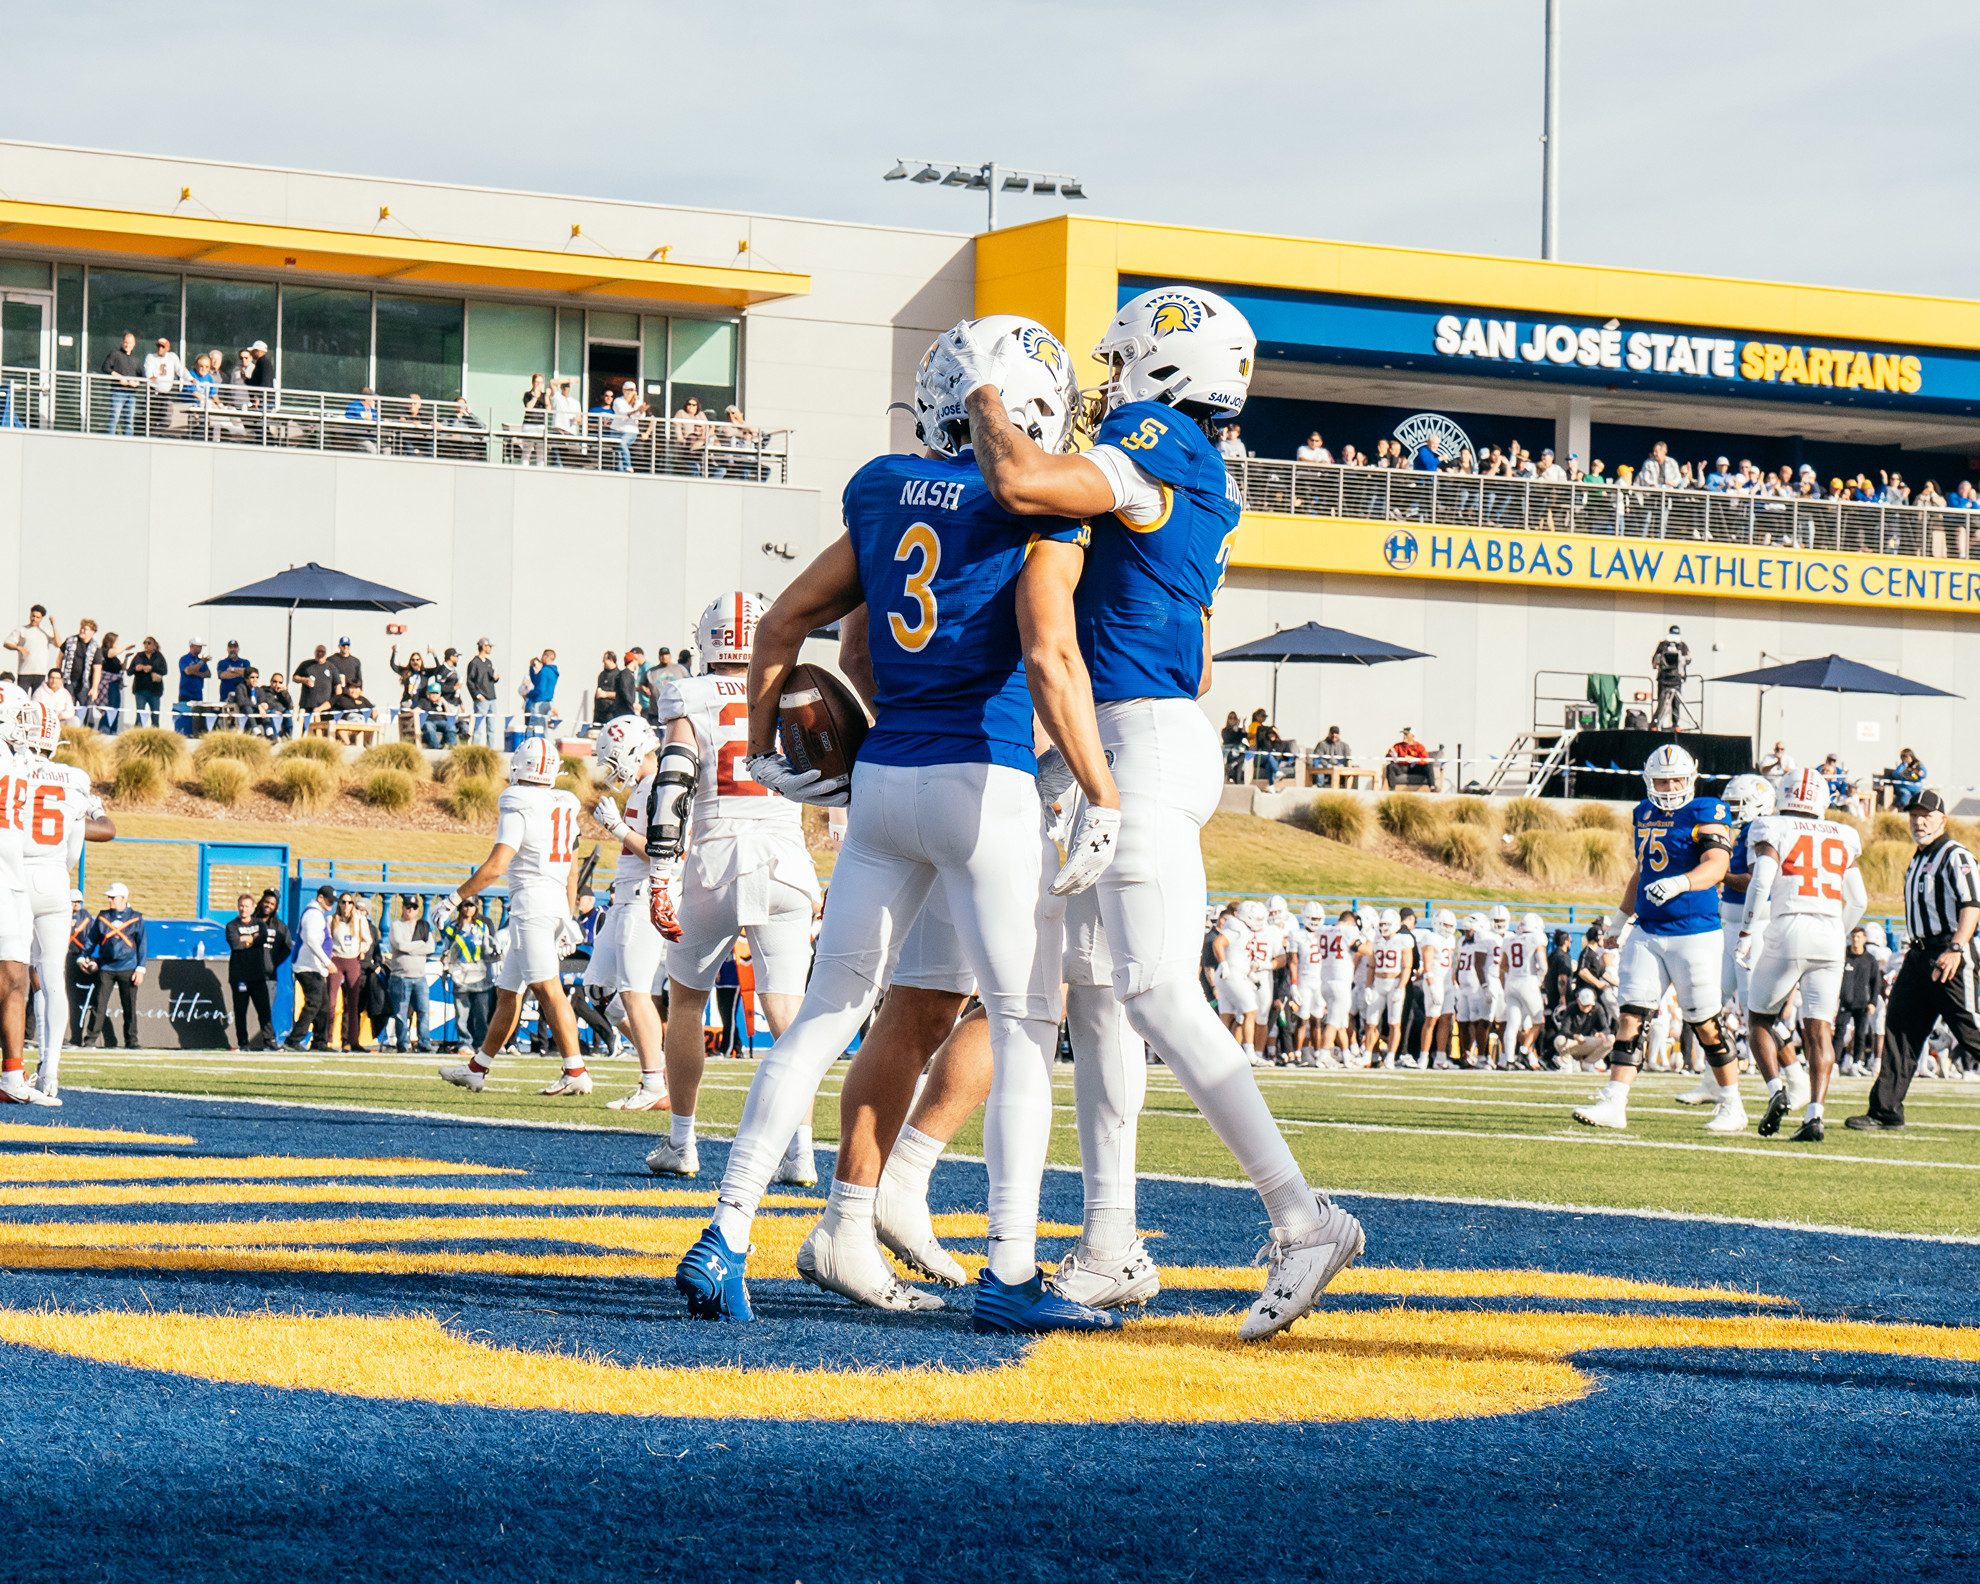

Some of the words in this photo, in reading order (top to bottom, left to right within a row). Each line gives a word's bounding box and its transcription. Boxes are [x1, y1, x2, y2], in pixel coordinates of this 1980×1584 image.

[1435, 315, 1516, 360] SAN
[1521, 318, 1622, 368] JOSÉ
[1626, 332, 1735, 378] STATE
[1740, 341, 1922, 393] SPARTANS
[1208, 392, 1230, 404] SAN
[1230, 396, 1244, 408] JOS
[900, 480, 965, 511] NASH
[887, 521, 942, 653] 3
[1431, 535, 1573, 577] HABBAS
[1590, 546, 1664, 582] LAW
[1673, 554, 1848, 593] ATHLETICS
[1861, 566, 1980, 602] CENTER
[716, 681, 747, 695] EDW
[717, 703, 782, 796] 2
[32, 785, 65, 846] 6
[549, 806, 571, 862] 11
[1792, 820, 1839, 834] JACKSON
[1638, 828, 1669, 873] 75
[1781, 835, 1849, 901] 49
[1319, 934, 1343, 959] 94
[1375, 949, 1397, 969] 39
[1511, 943, 1523, 968] 8
